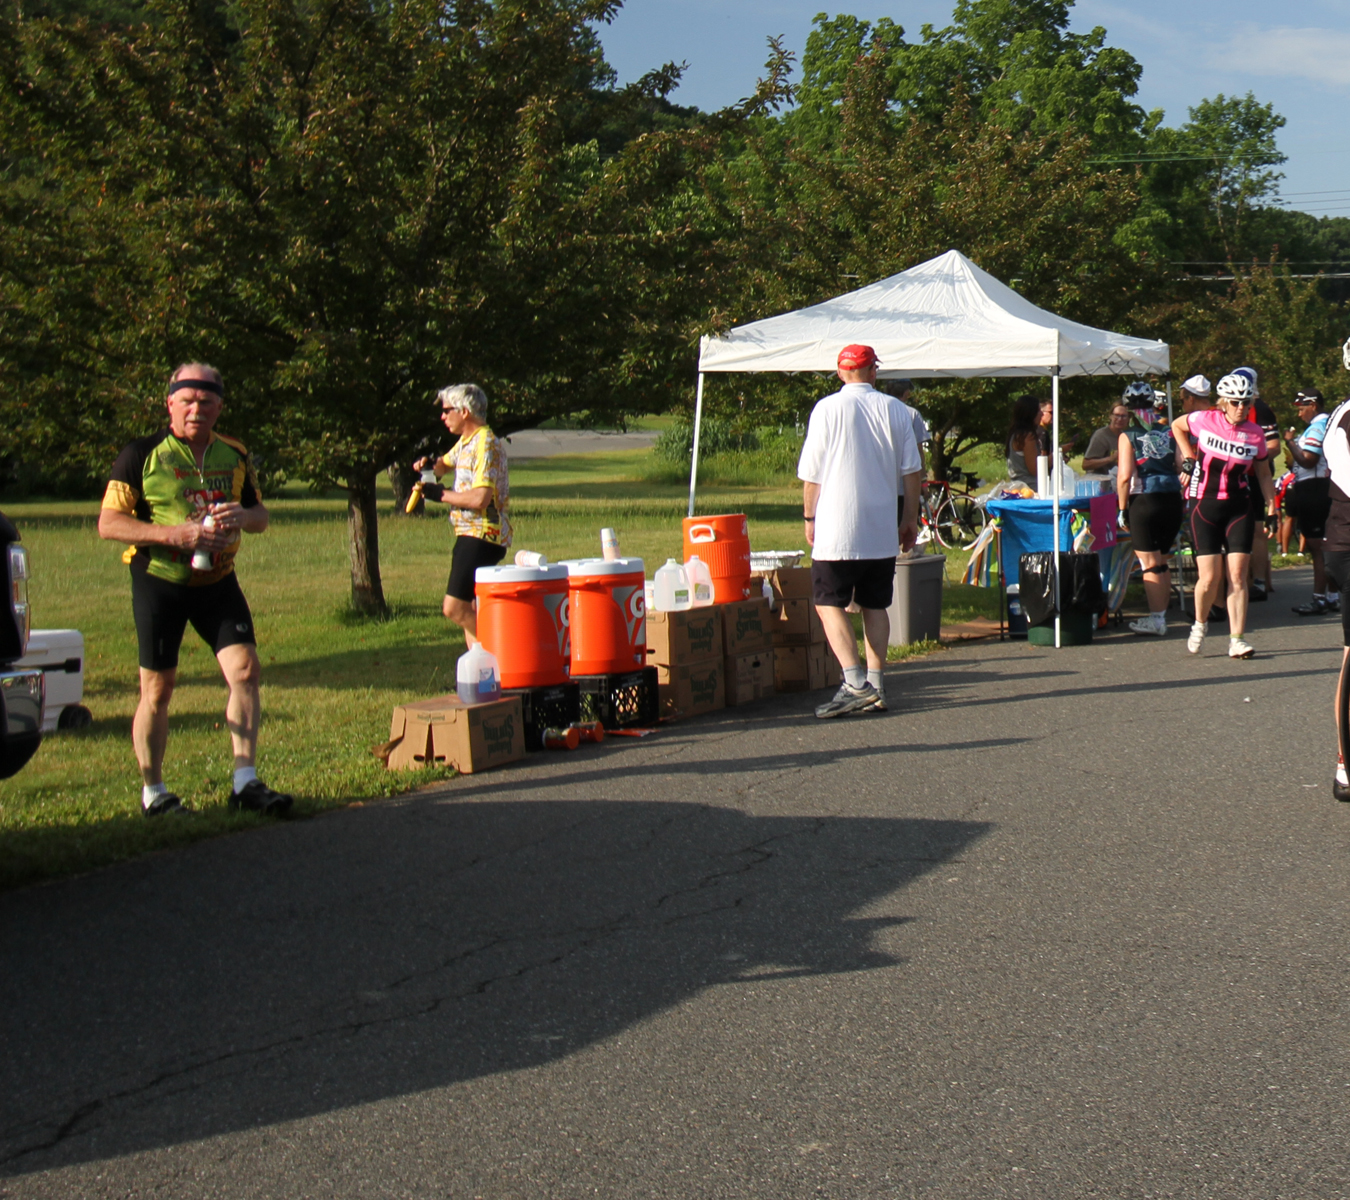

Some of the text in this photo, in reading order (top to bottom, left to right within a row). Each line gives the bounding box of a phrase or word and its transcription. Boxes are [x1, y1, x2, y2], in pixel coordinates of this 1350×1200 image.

[1207, 436, 1251, 457] HILLTOP
[1189, 460, 1201, 497] HILLTOP
[630, 588, 645, 618] G
